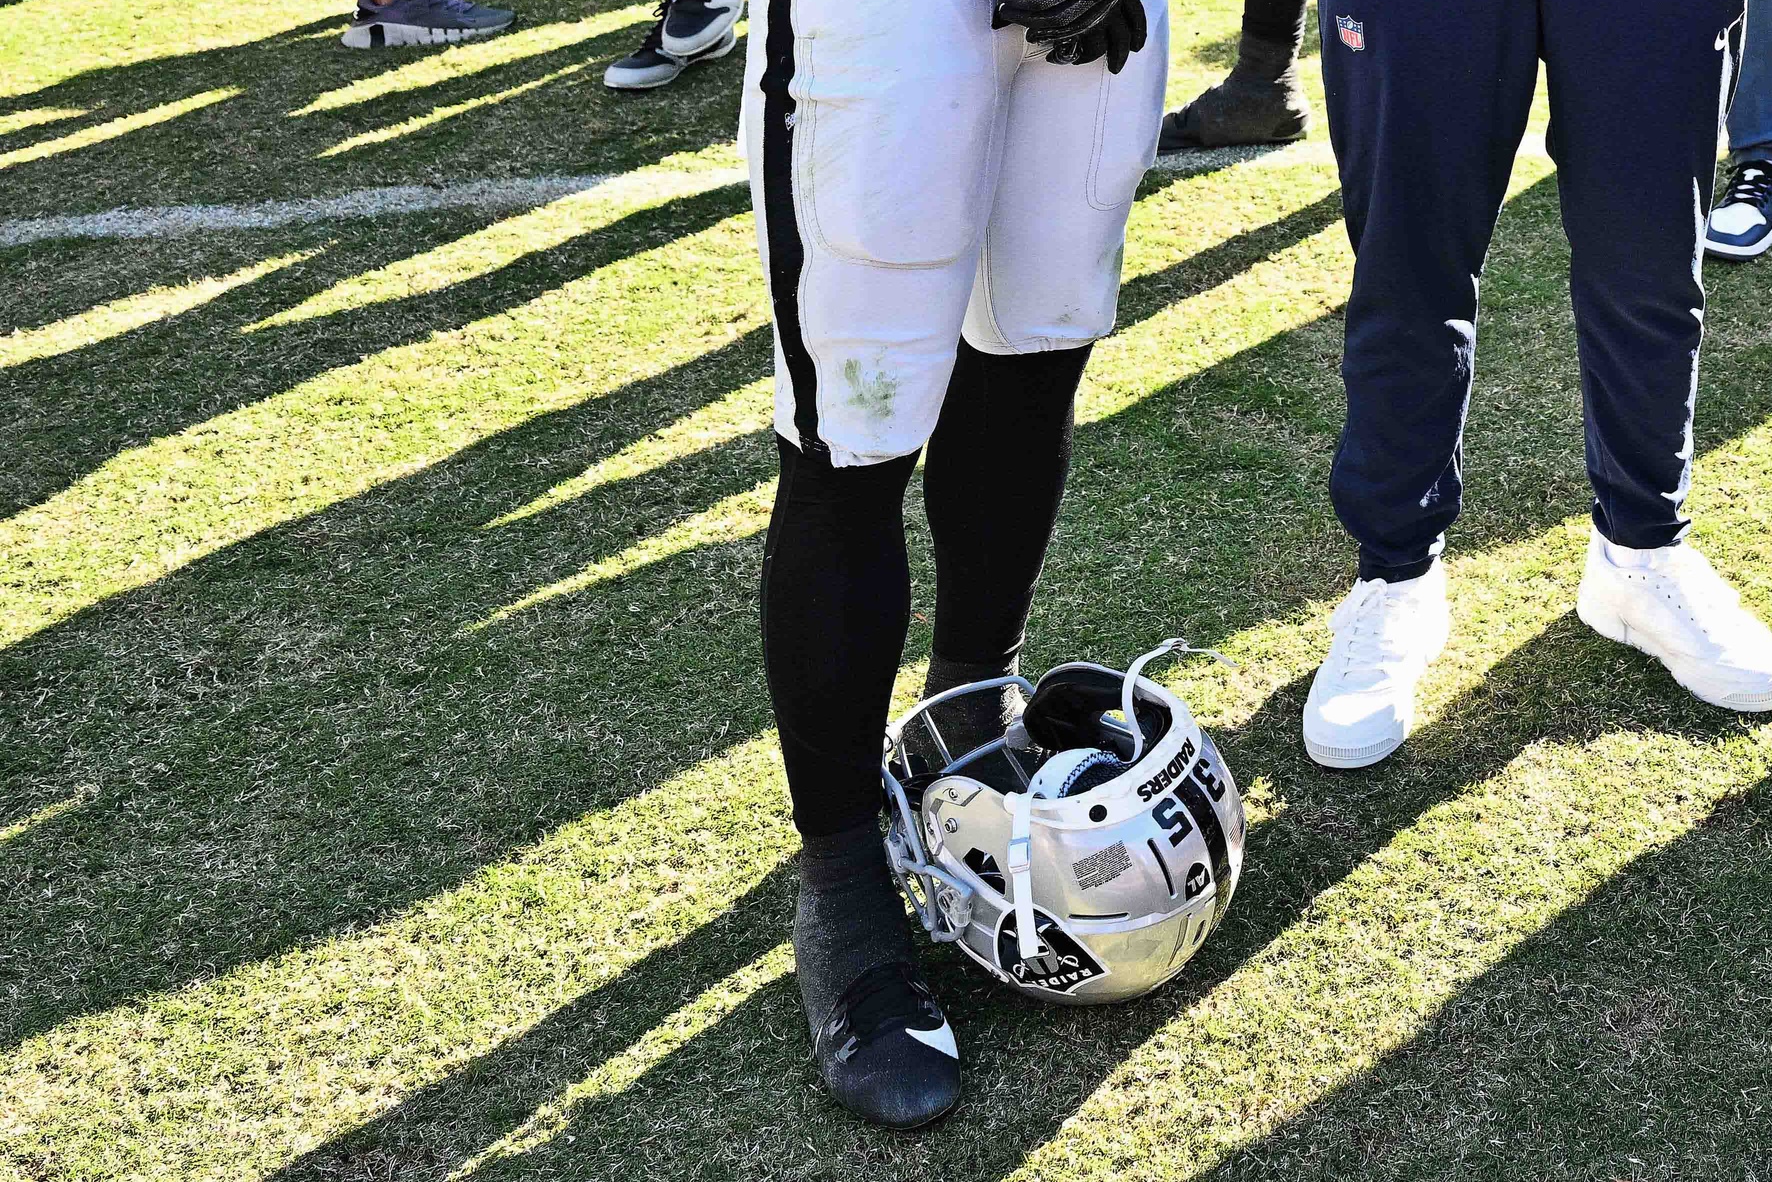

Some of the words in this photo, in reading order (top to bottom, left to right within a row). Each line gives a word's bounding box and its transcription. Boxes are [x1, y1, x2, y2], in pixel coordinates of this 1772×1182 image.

[1137, 737, 1196, 803] RAIDERS
[1188, 868, 1206, 893] AL
[1032, 968, 1093, 987] RAIDE
